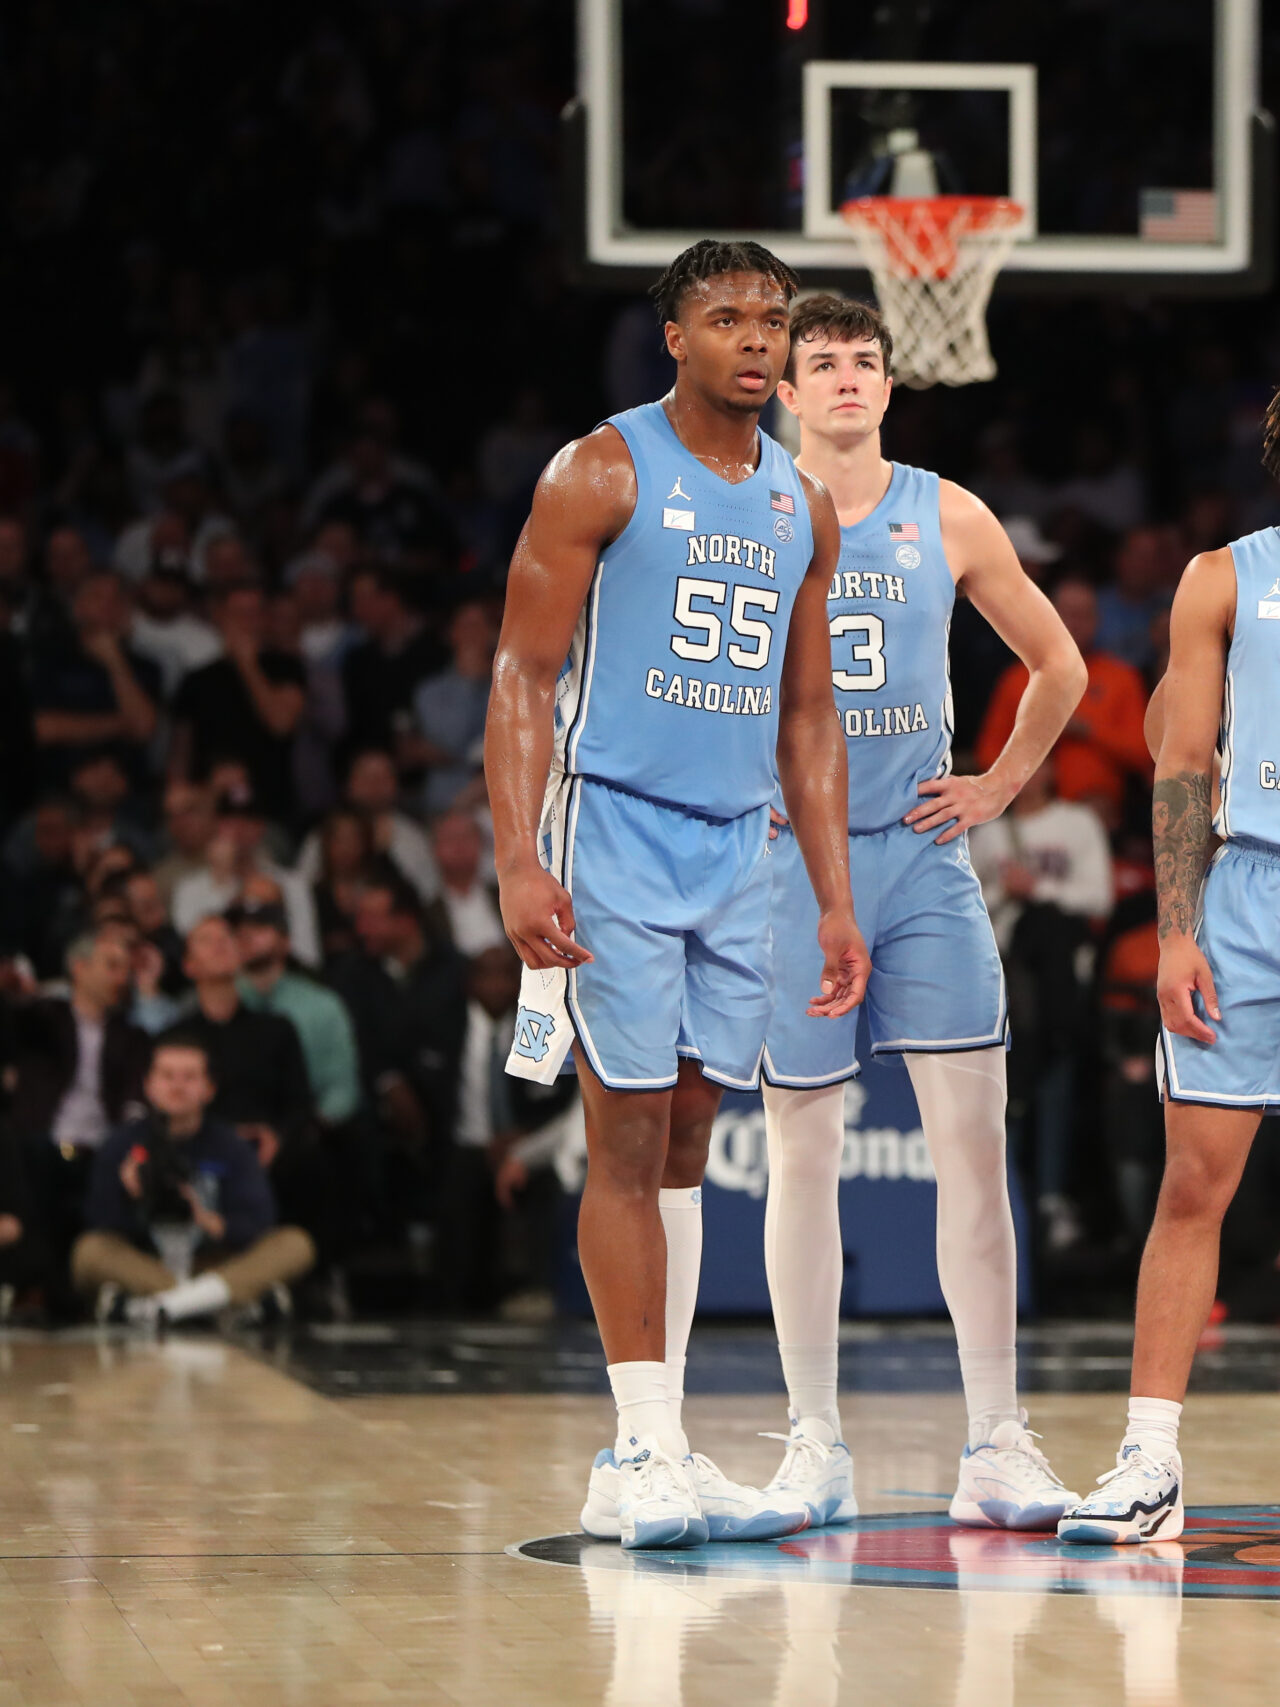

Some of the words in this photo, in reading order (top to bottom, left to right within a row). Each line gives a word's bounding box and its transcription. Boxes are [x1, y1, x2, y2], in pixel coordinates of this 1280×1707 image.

[686, 534, 776, 579] NORTH
[827, 571, 907, 603] ORTH
[670, 576, 779, 670] 55
[829, 613, 887, 692] 3
[645, 667, 772, 715] CAROLINA
[836, 703, 929, 737] OLINA
